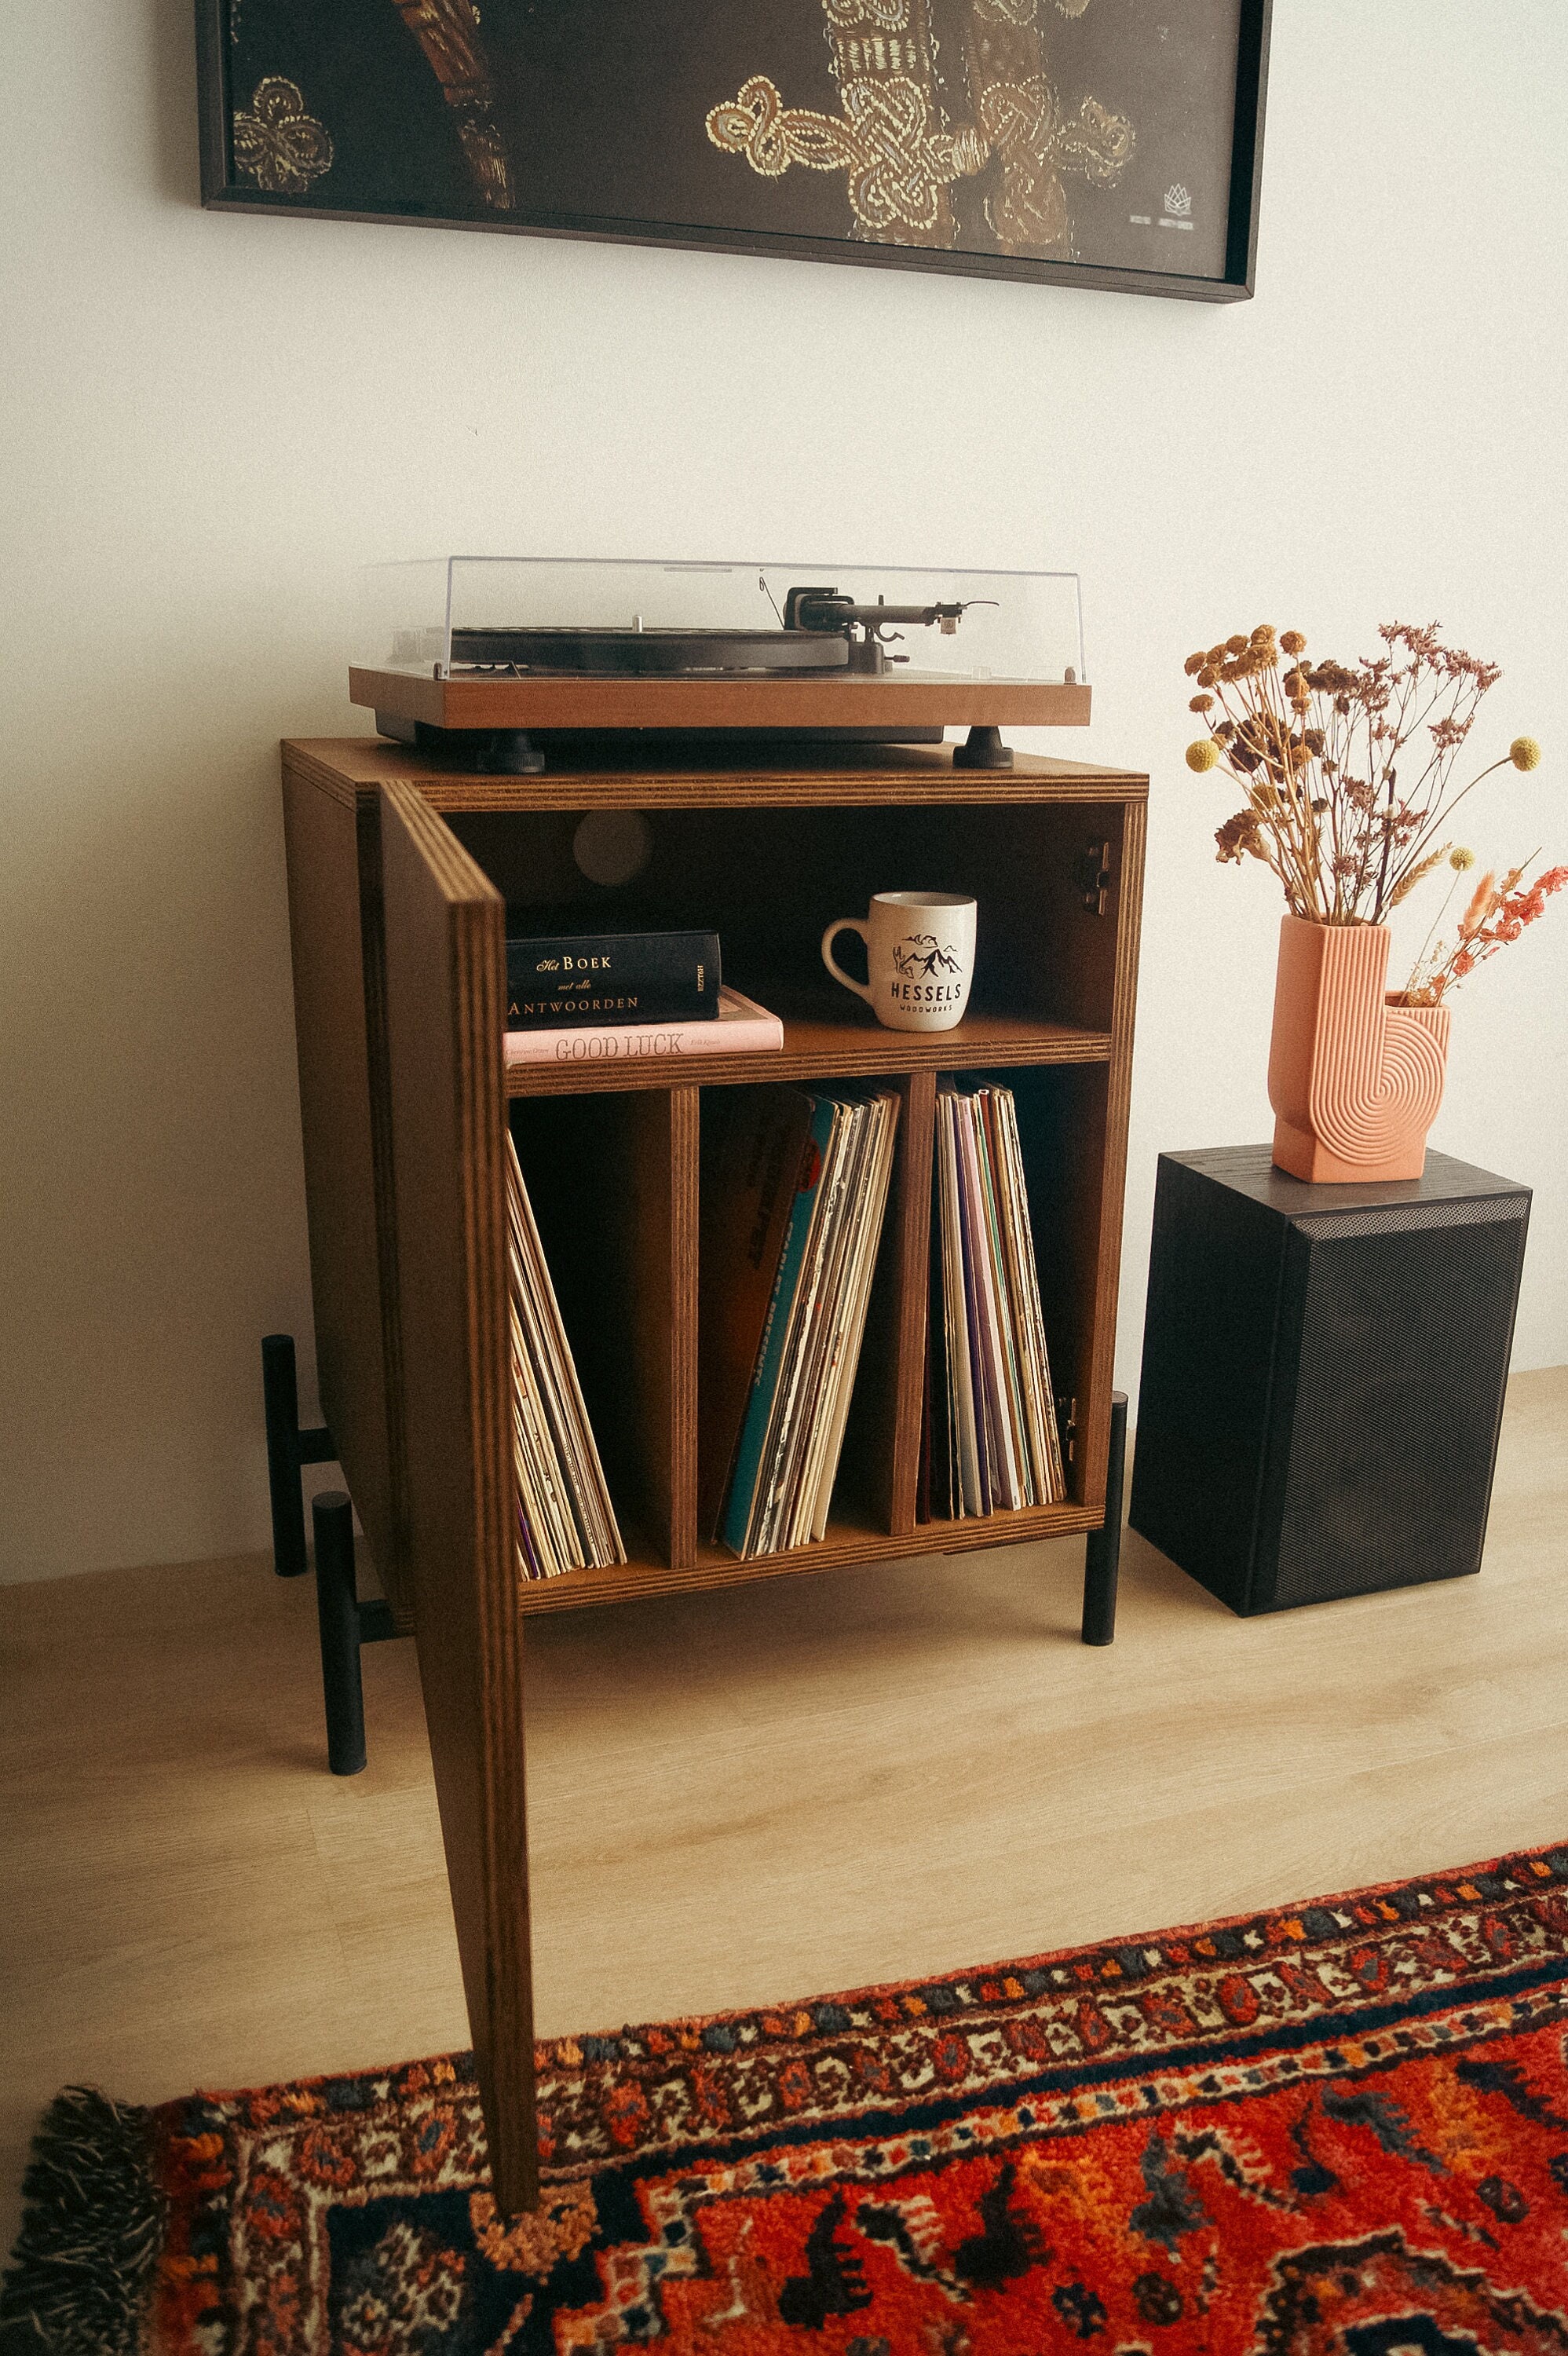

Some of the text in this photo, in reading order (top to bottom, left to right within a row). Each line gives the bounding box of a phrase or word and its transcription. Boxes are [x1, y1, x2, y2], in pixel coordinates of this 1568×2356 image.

[536, 956, 612, 971] Het BOEK
[557, 979, 591, 991] met alle
[891, 982, 961, 1001] HESSELS
[508, 997, 638, 1015] ANTWOORDEN
[899, 1004, 952, 1013] WOODWORKS
[556, 1033, 684, 1060] GOOD LUCK
